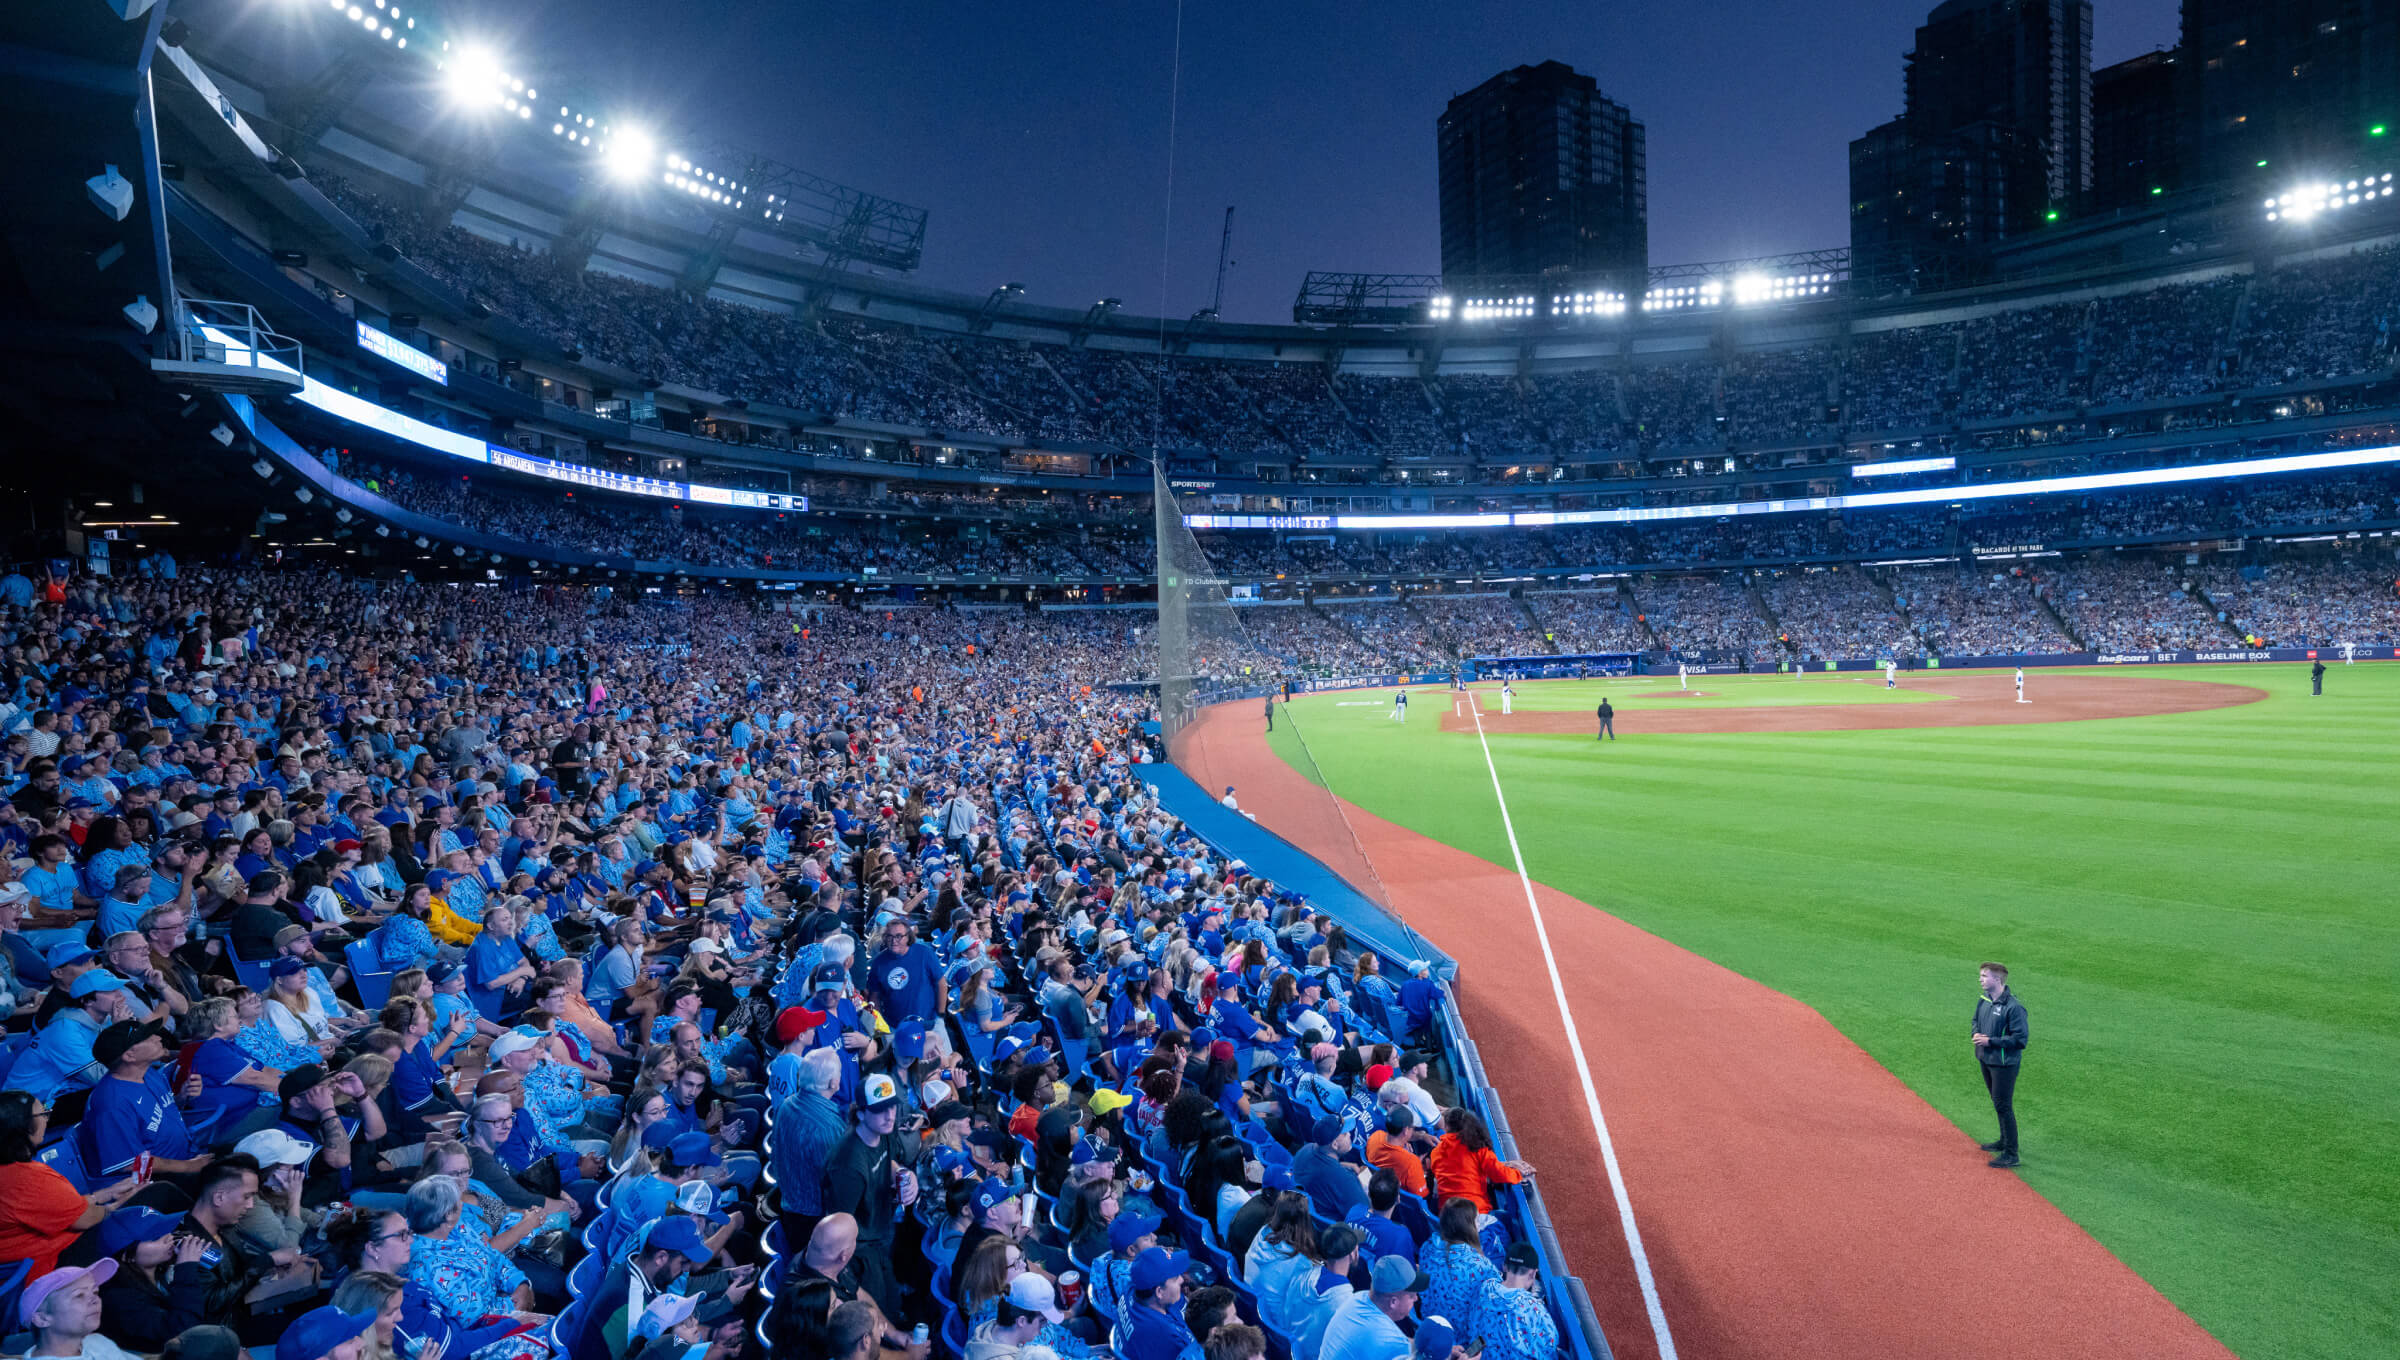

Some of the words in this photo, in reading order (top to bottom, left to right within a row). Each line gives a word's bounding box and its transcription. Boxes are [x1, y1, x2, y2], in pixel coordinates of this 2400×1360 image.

[1171, 480, 1216, 488] SPORTSNET
[2158, 653, 2178, 661] BET
[2338, 649, 2373, 659] gf.ca
[1686, 665, 1707, 674] VISA
